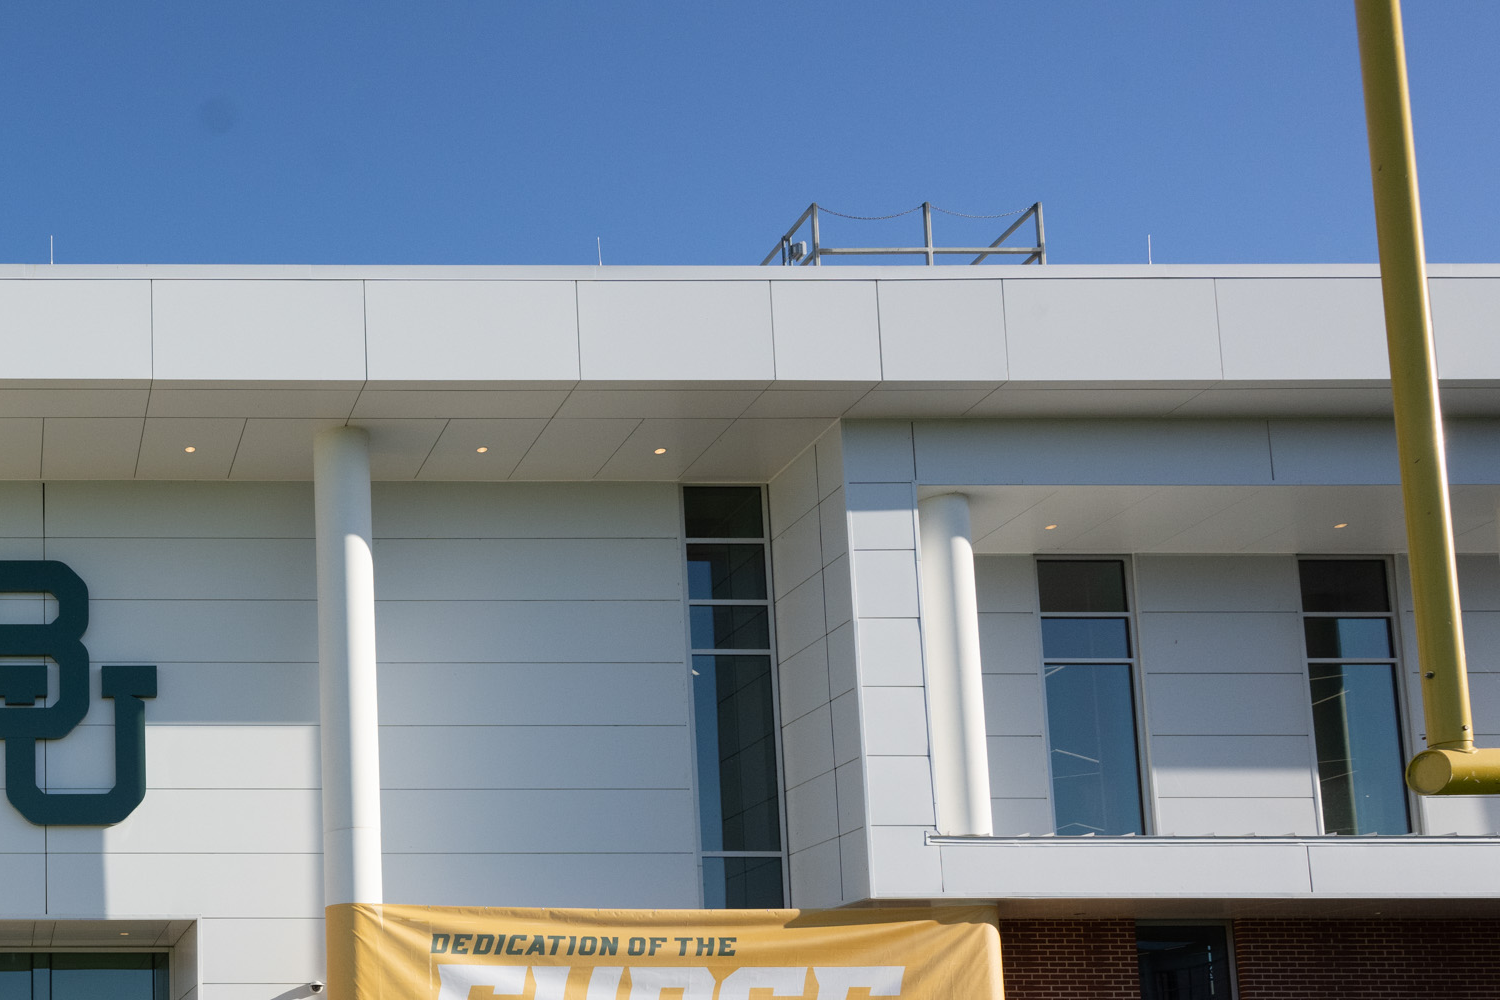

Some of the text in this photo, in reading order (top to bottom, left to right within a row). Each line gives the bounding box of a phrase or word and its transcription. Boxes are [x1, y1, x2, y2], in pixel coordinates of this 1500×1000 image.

[430, 933, 737, 957] DEDICATION OF THE
